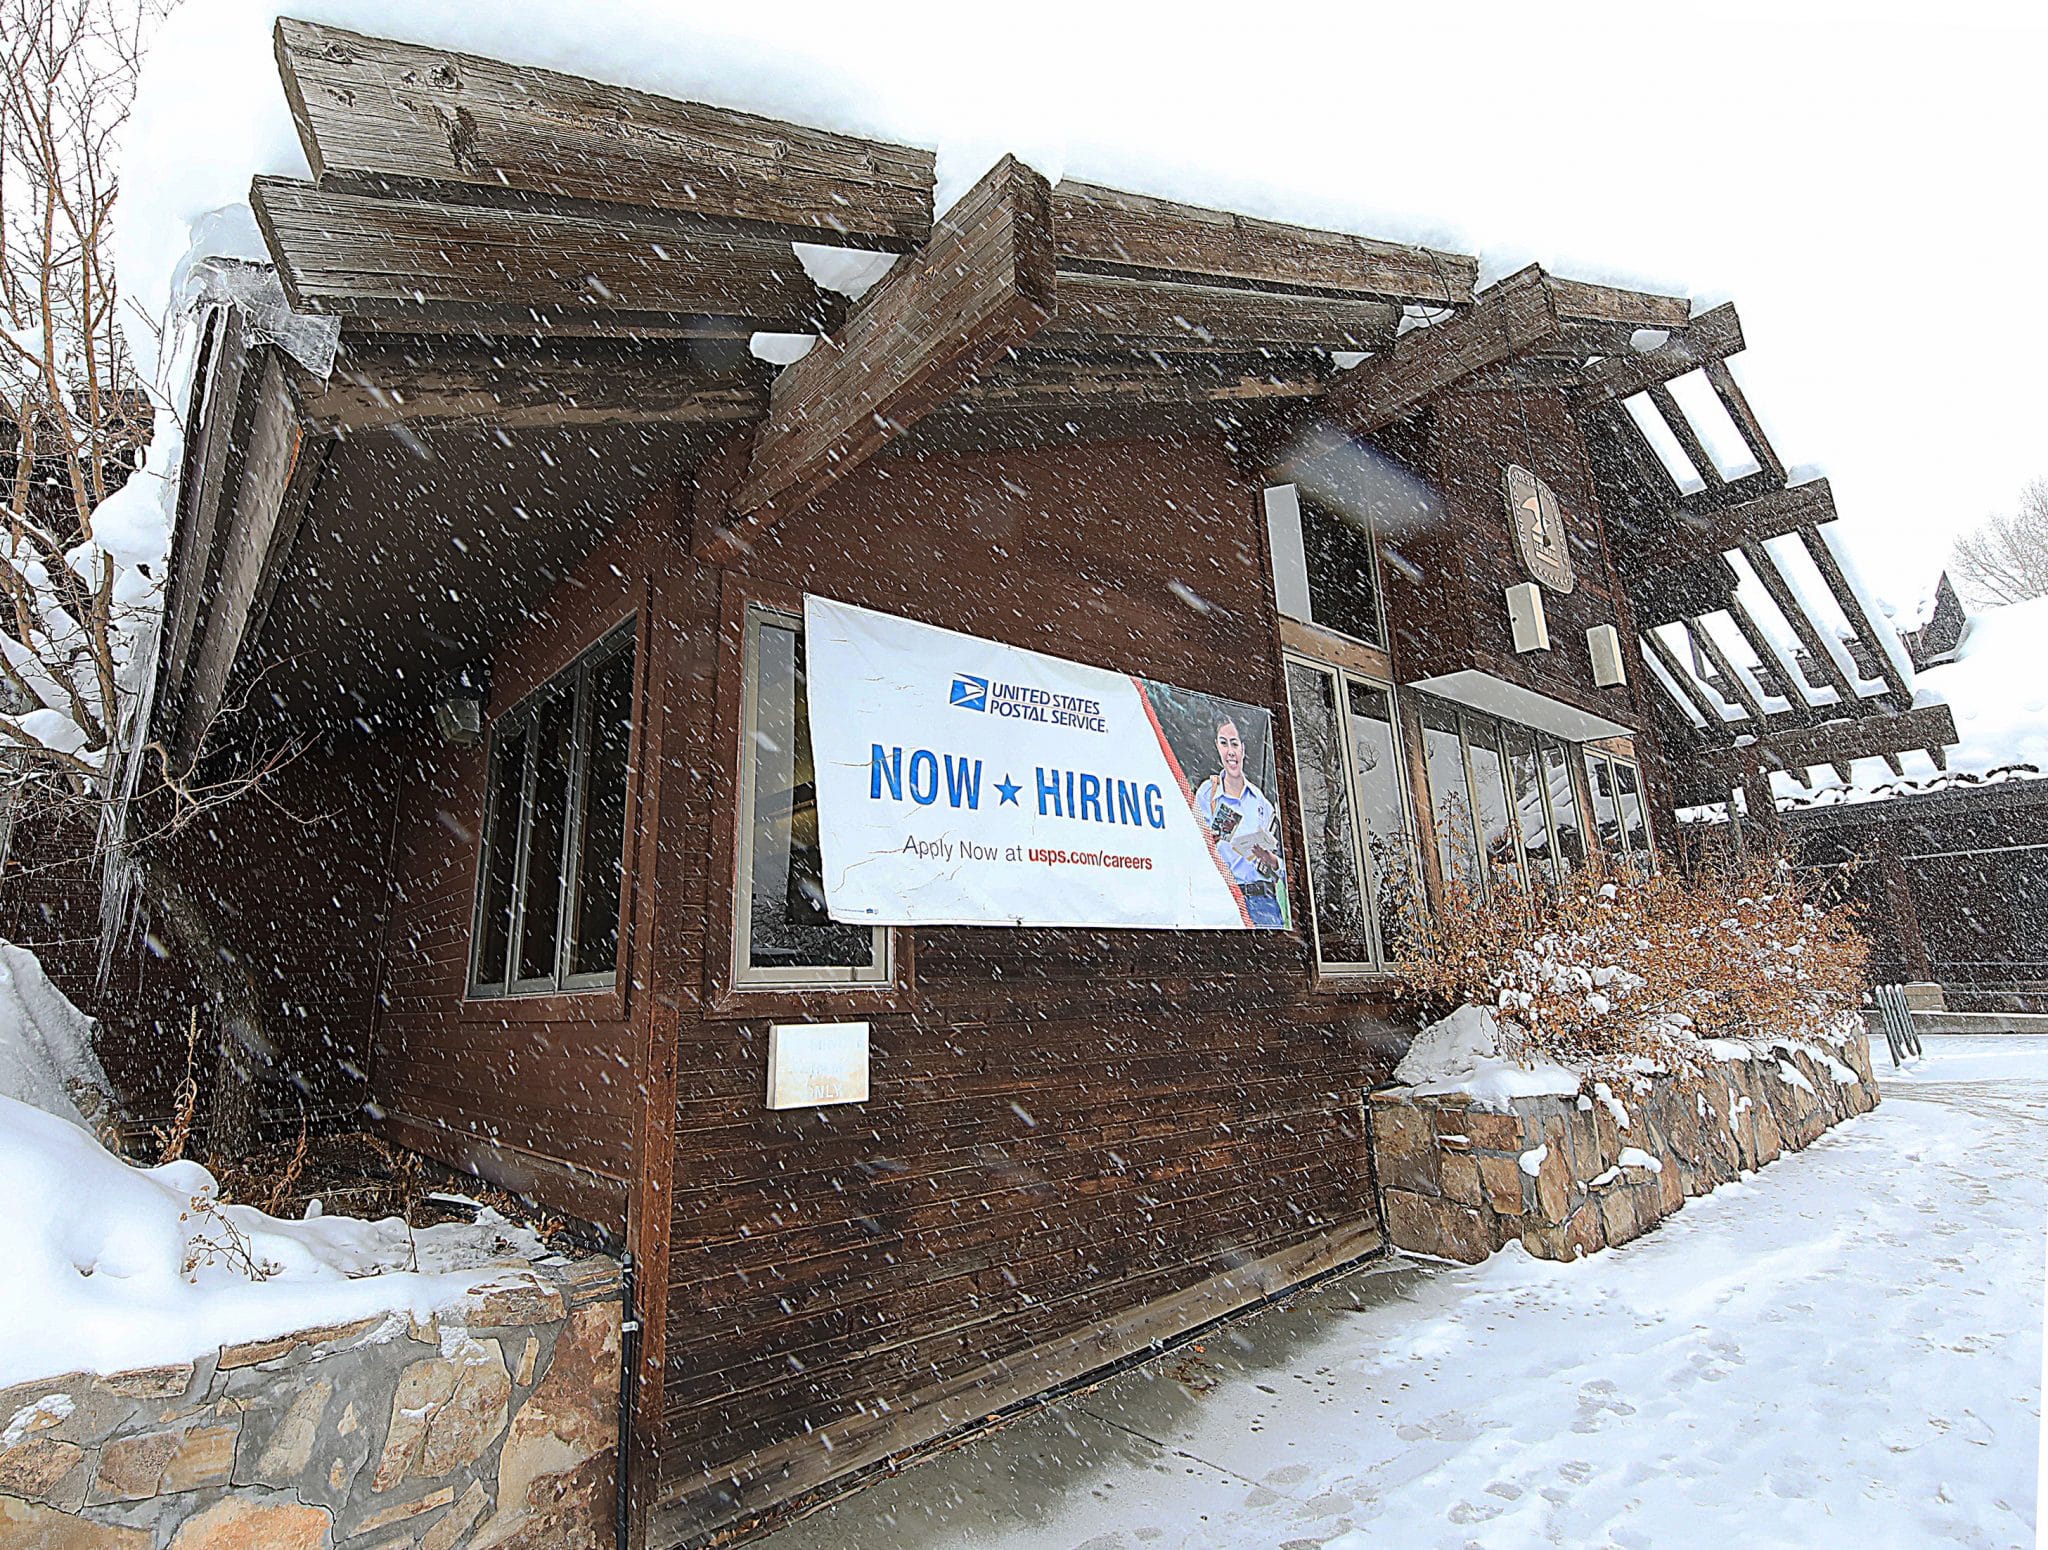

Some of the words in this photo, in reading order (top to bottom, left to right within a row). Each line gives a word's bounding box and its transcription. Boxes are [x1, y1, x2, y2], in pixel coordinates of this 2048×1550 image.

[992, 682, 1050, 705] UNITED
[1053, 694, 1100, 715] STATES
[990, 699, 1048, 722] POSTAL
[1051, 709, 1106, 733] SERVICE
[870, 743, 983, 810] NOW
[1035, 766, 1166, 830] HIRING
[902, 835, 953, 861] Apply
[960, 840, 998, 861] Now
[1005, 845, 1023, 862] at
[1028, 847, 1153, 870] usps.com/careers
